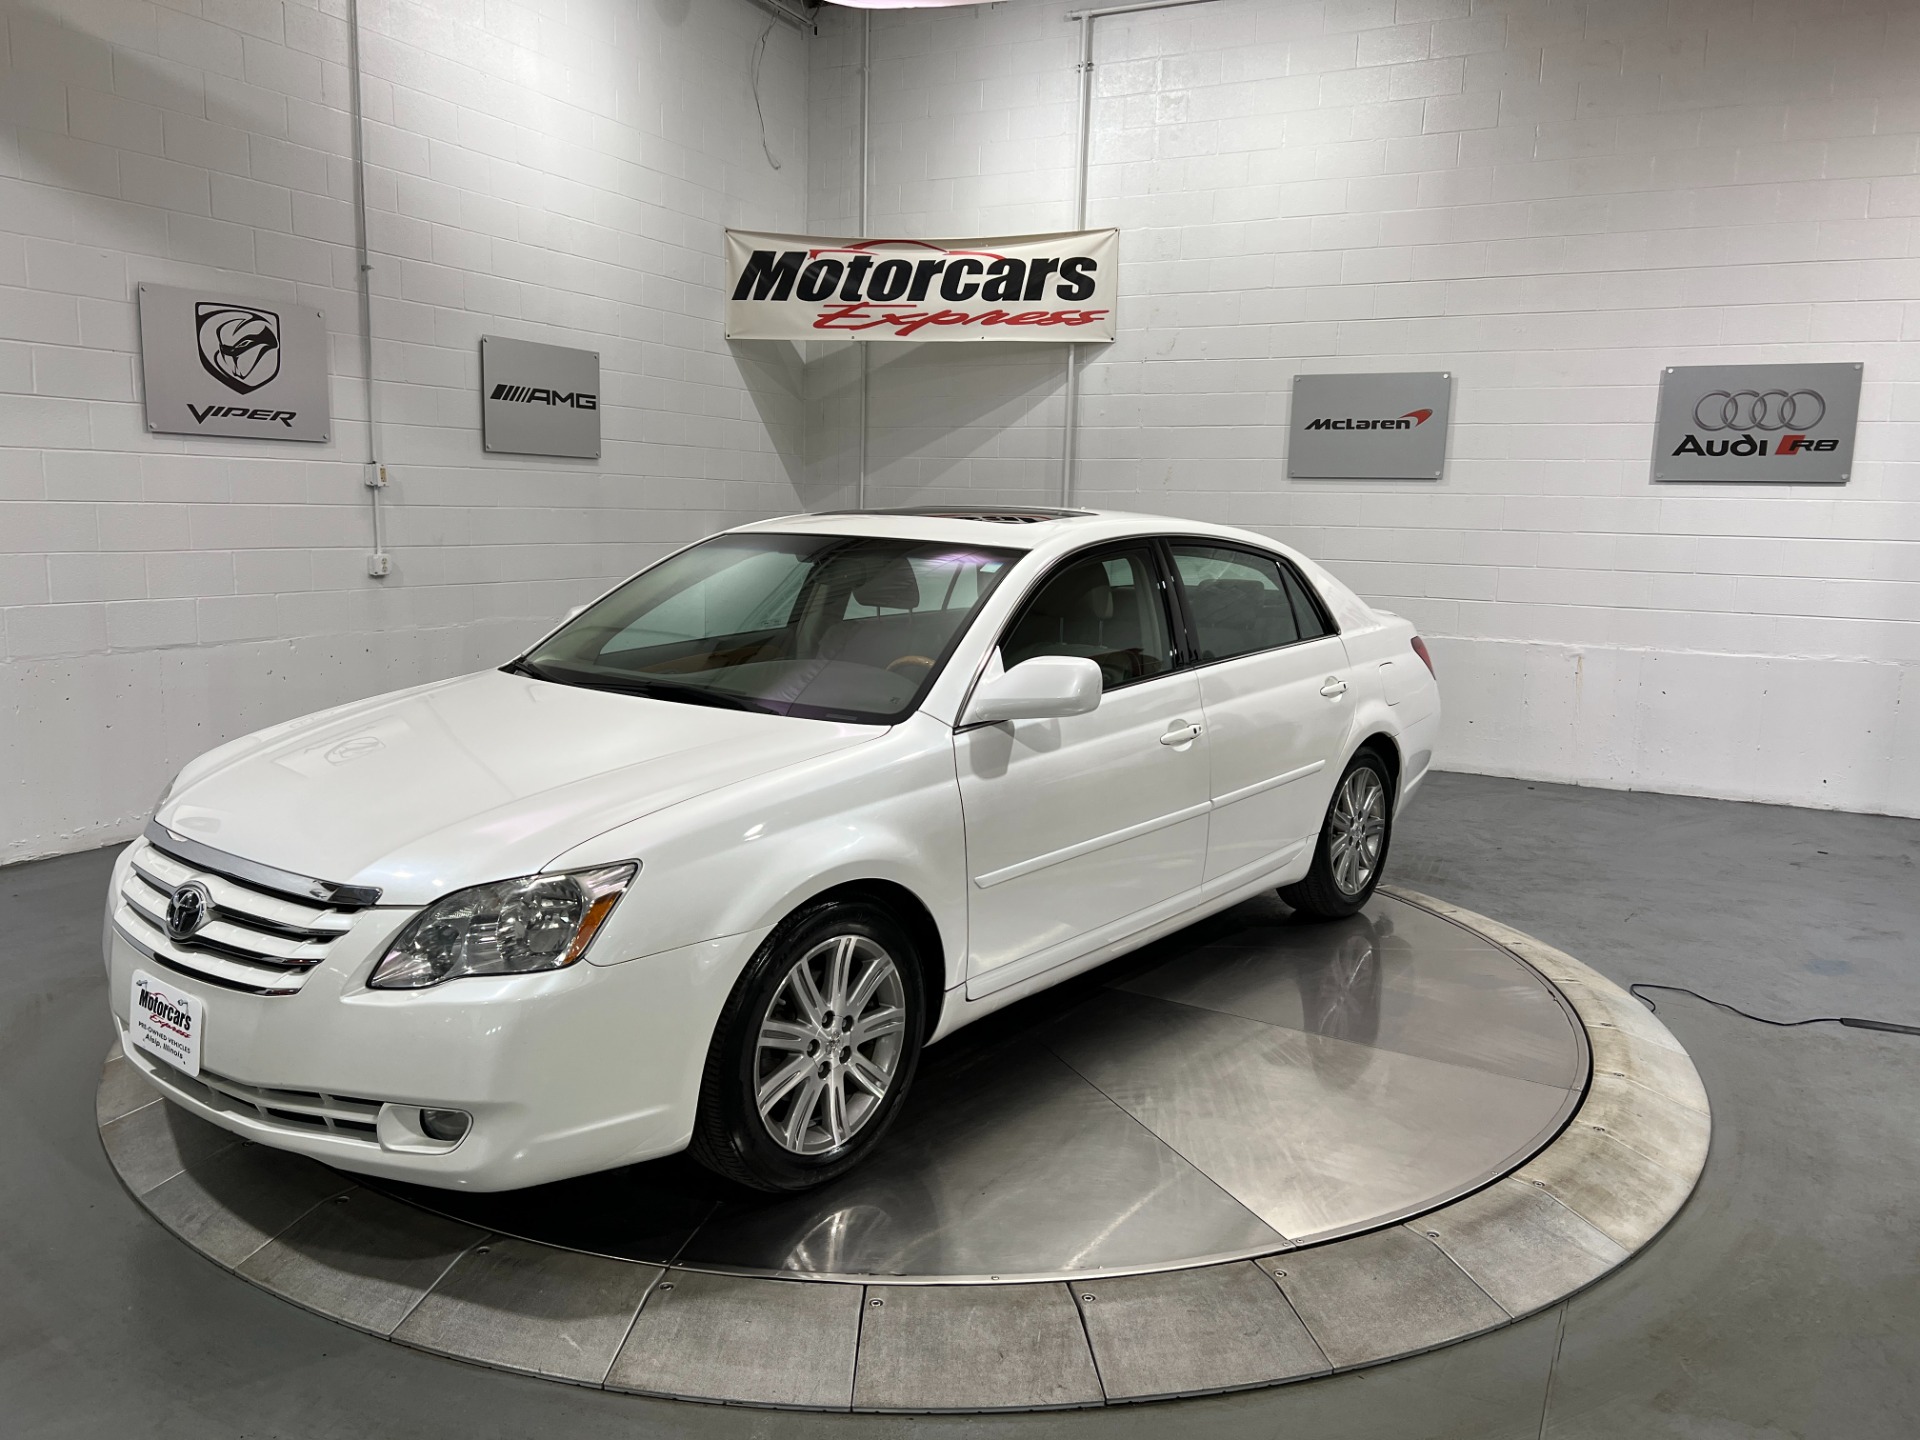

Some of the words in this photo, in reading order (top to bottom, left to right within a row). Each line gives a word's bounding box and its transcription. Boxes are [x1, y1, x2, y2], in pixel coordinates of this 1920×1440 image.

[731, 250, 1098, 301] Motorcars
[812, 302, 1109, 336] Express
[528, 386, 598, 410] AMG
[186, 403, 297, 427] VIPER
[1304, 418, 1411, 431] McLaren
[1671, 434, 1768, 457] Audi
[1789, 438, 1840, 452] R8
[138, 988, 192, 1031] Motorcars
[138, 1020, 168, 1041] PRE-OWNED
[149, 1013, 192, 1039] Express
[162, 1041, 184, 1060] Illinois
[168, 1035, 191, 1054] VEHICLES
